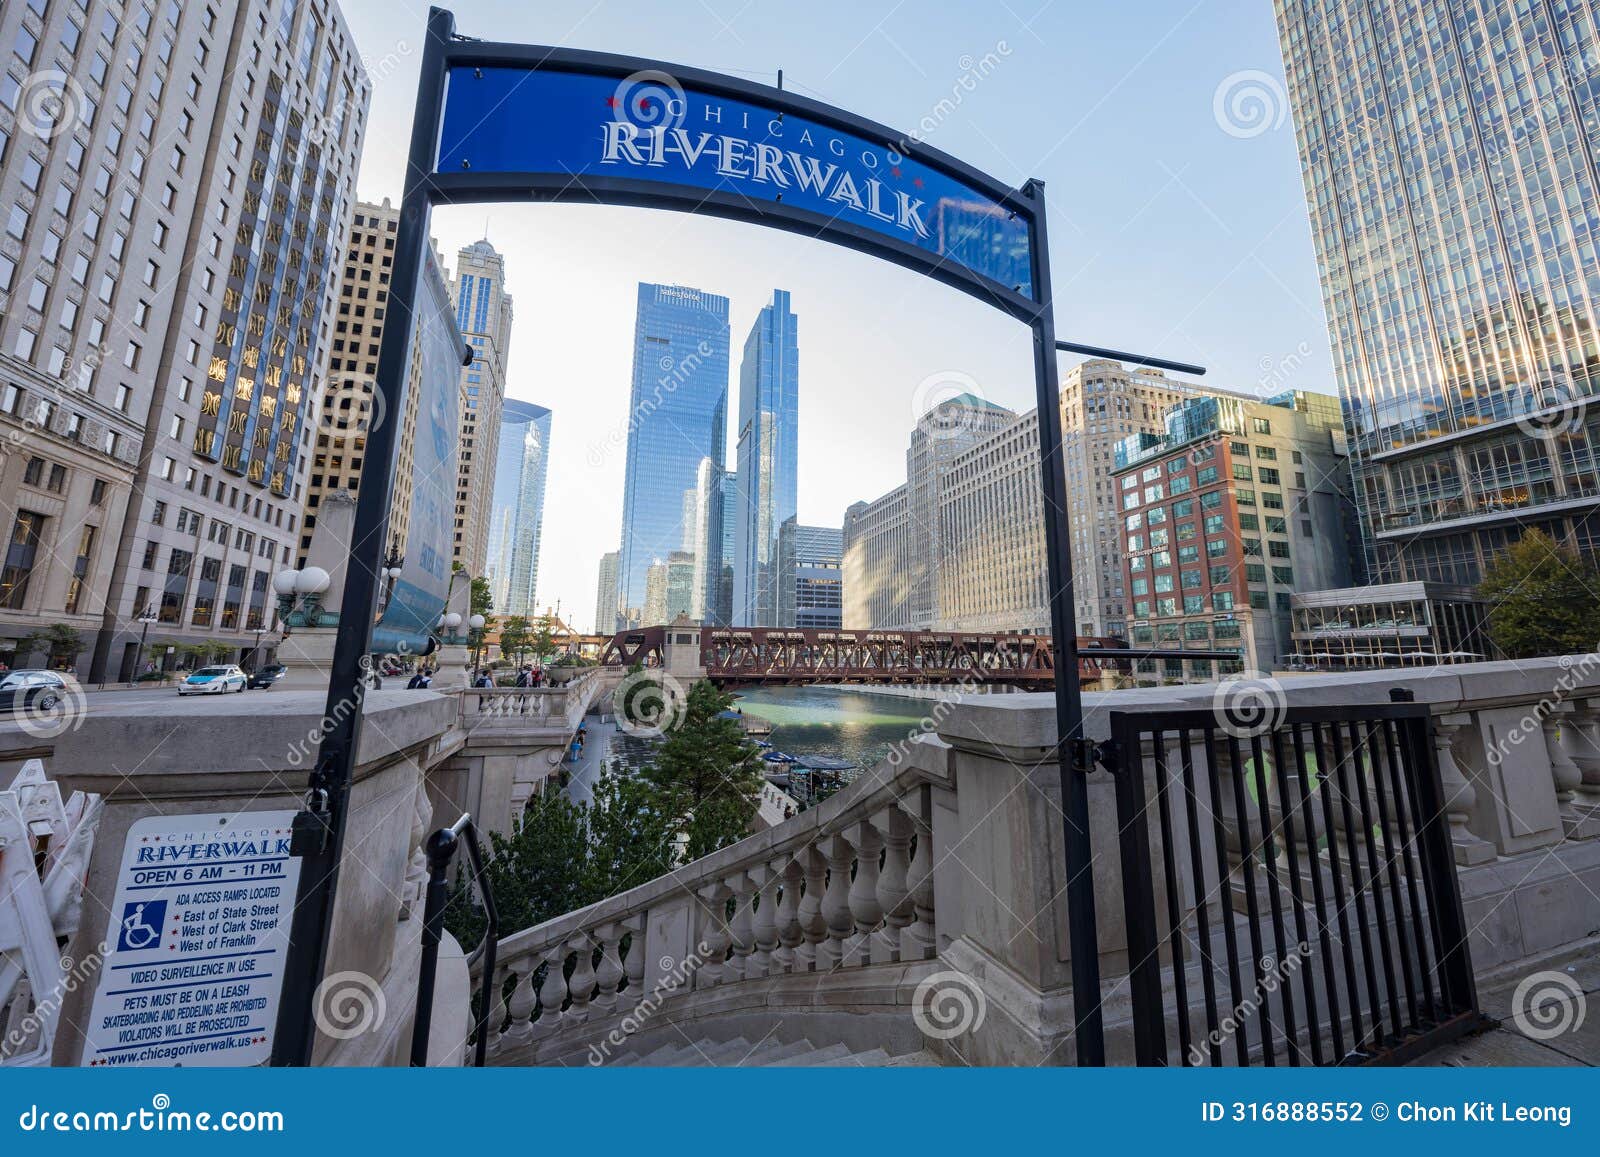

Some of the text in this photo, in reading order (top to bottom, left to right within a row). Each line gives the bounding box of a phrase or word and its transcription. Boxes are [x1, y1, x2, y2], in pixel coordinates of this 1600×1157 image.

[666, 98, 879, 169] CHICAGO
[600, 121, 934, 240] RIVERWALK
[661, 288, 700, 301] salesforce
[167, 830, 270, 843] CHICAGO
[137, 839, 291, 863] RIVERWALK
[134, 870, 177, 884] OPEN
[183, 869, 193, 880] 6
[199, 867, 222, 879] AM
[243, 864, 255, 875] 11
[261, 862, 282, 875] PM
[175, 886, 280, 906] ADA ACCESS RAMPS LOCATED
[184, 904, 279, 922] East of State Street
[181, 918, 278, 937] West of Clark Street
[180, 935, 256, 952] West of Franklin
[131, 959, 256, 984] VIDEO SURVEILLENCE IN USE
[123, 984, 250, 1010] PETS MUST BE ON A LEASH
[103, 997, 267, 1029] SKATEBOARDING AND PEDDELING ARE PROHIBITED
[119, 1015, 250, 1043] VIOLATORS WILL BE PROSECUTED
[108, 1036, 251, 1065] www.chicagoriverwalk.us
